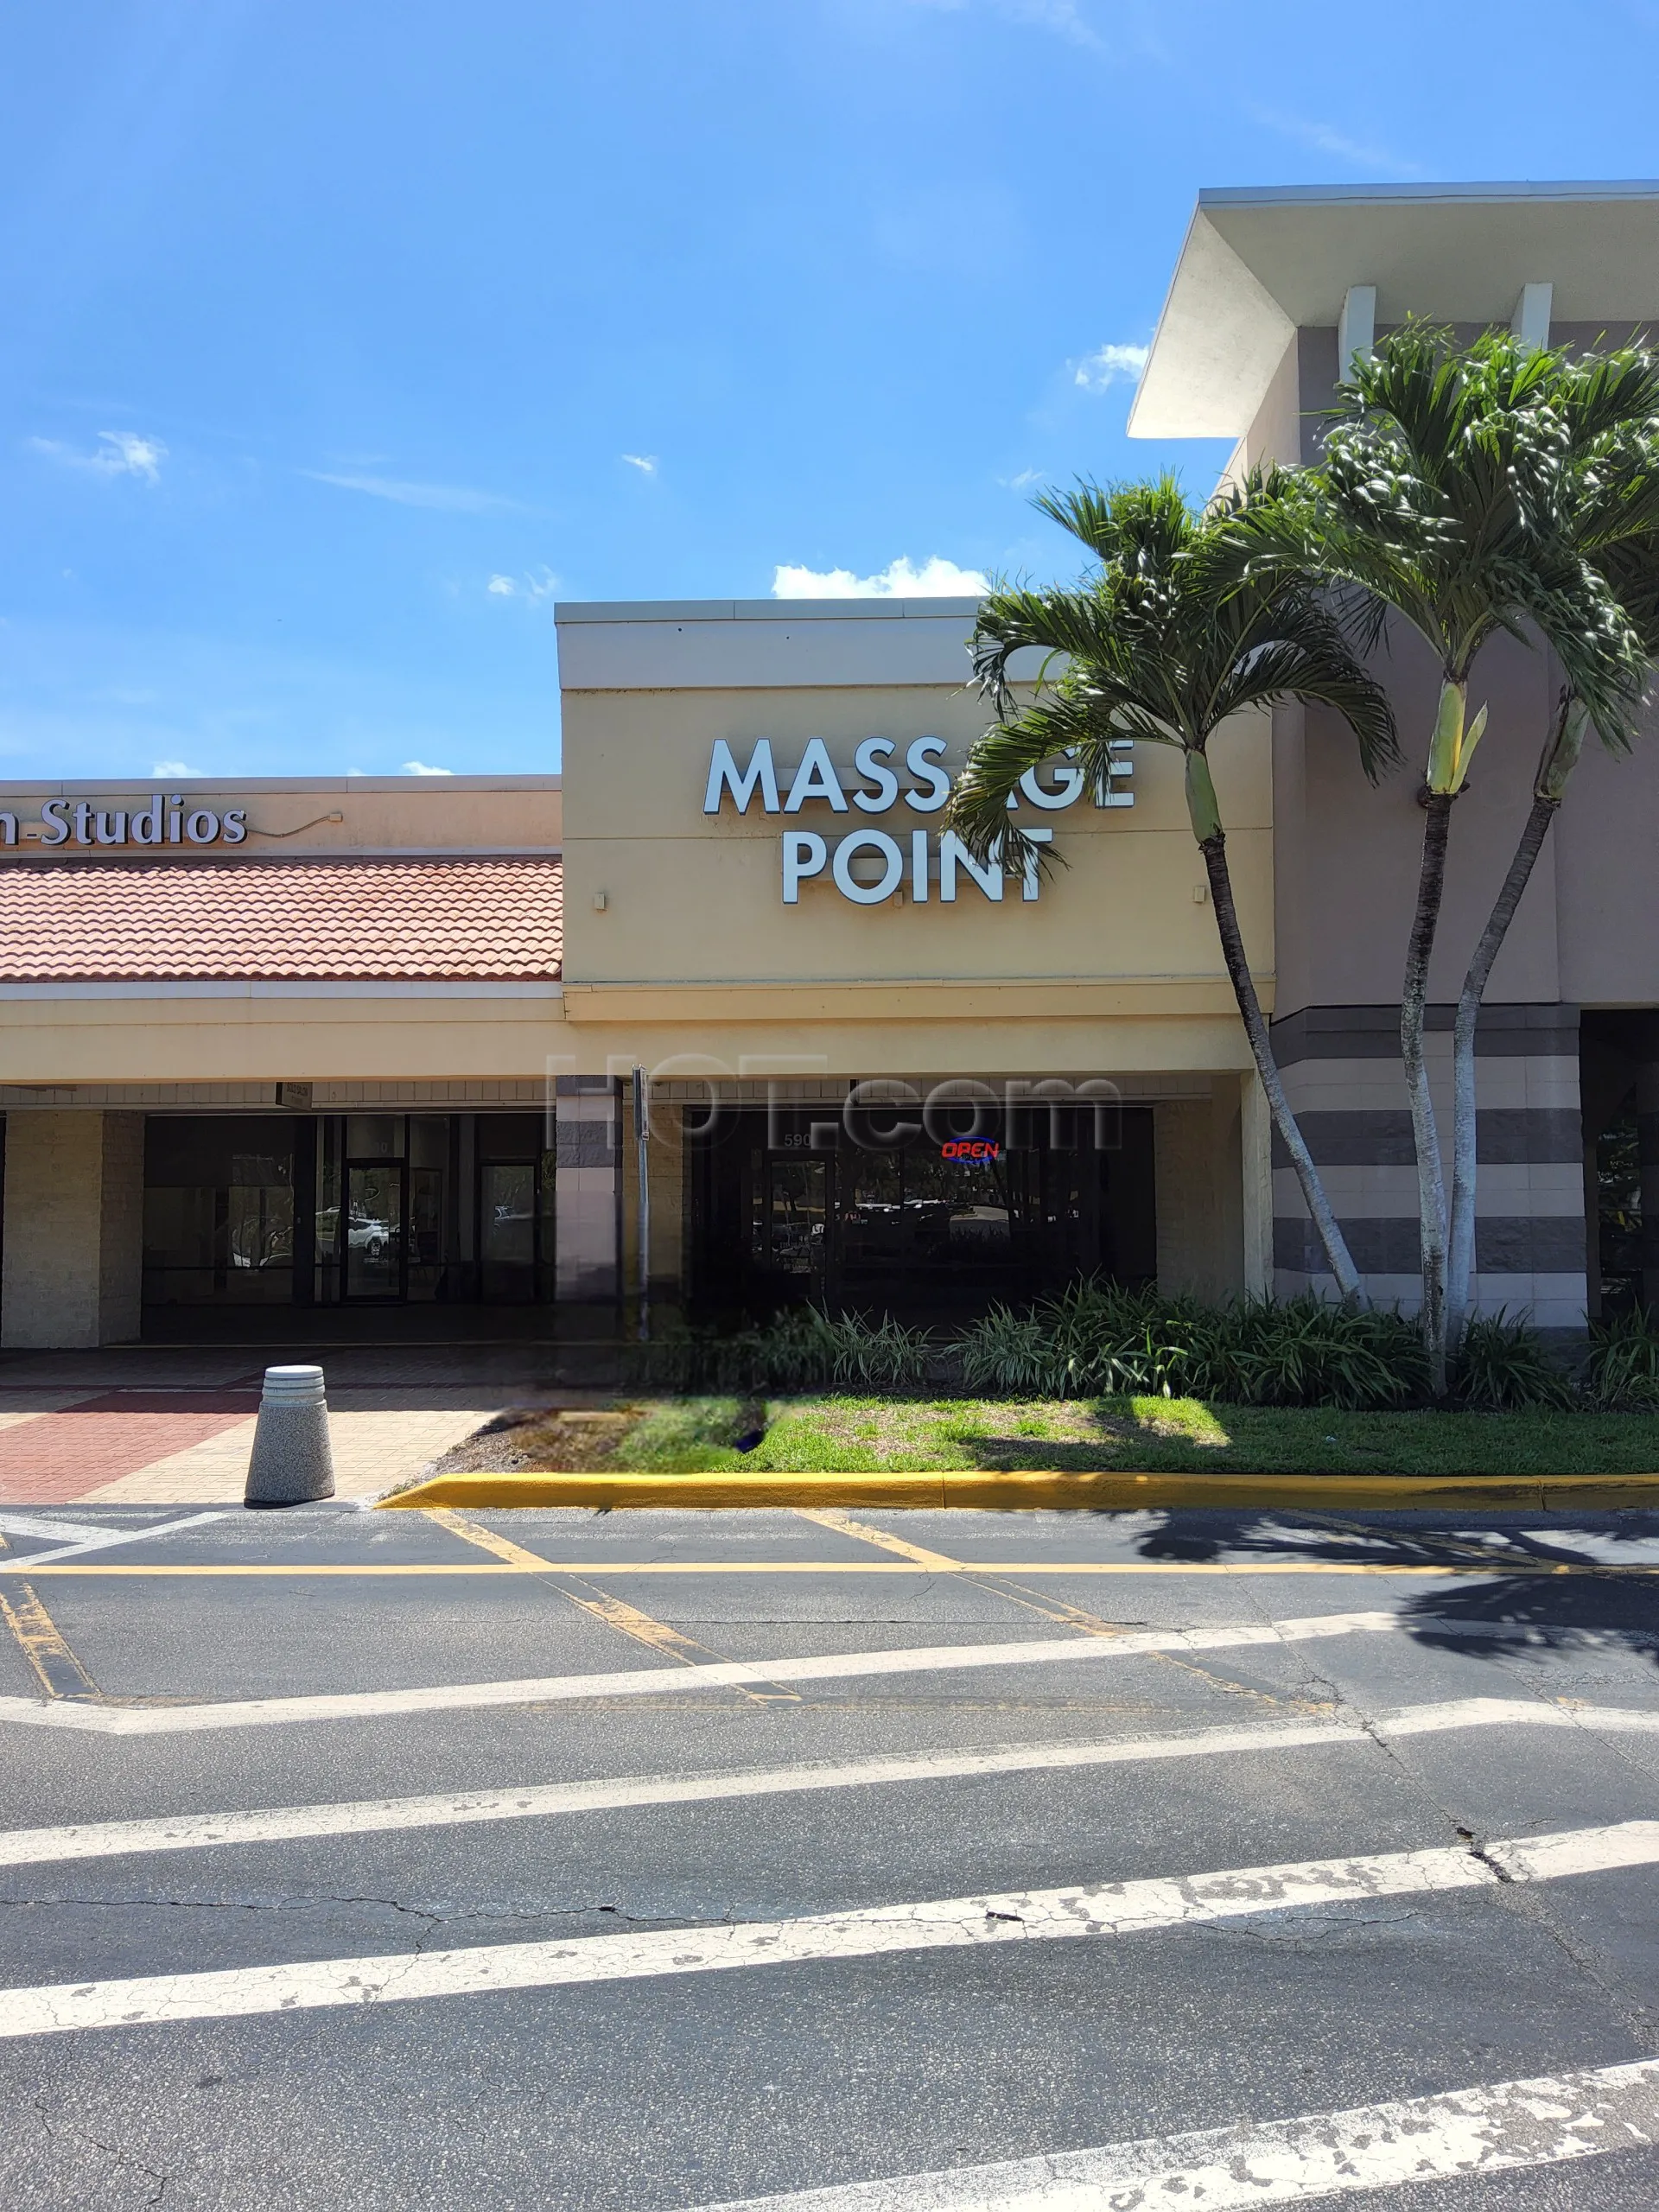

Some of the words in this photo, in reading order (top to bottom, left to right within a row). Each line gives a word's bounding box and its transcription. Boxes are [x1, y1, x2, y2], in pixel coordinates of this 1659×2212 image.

[702, 736, 1135, 815] MASSGE
[41, 794, 248, 846] Studios
[782, 828, 1052, 905] POINT
[942, 1142, 999, 1159] OPEN
